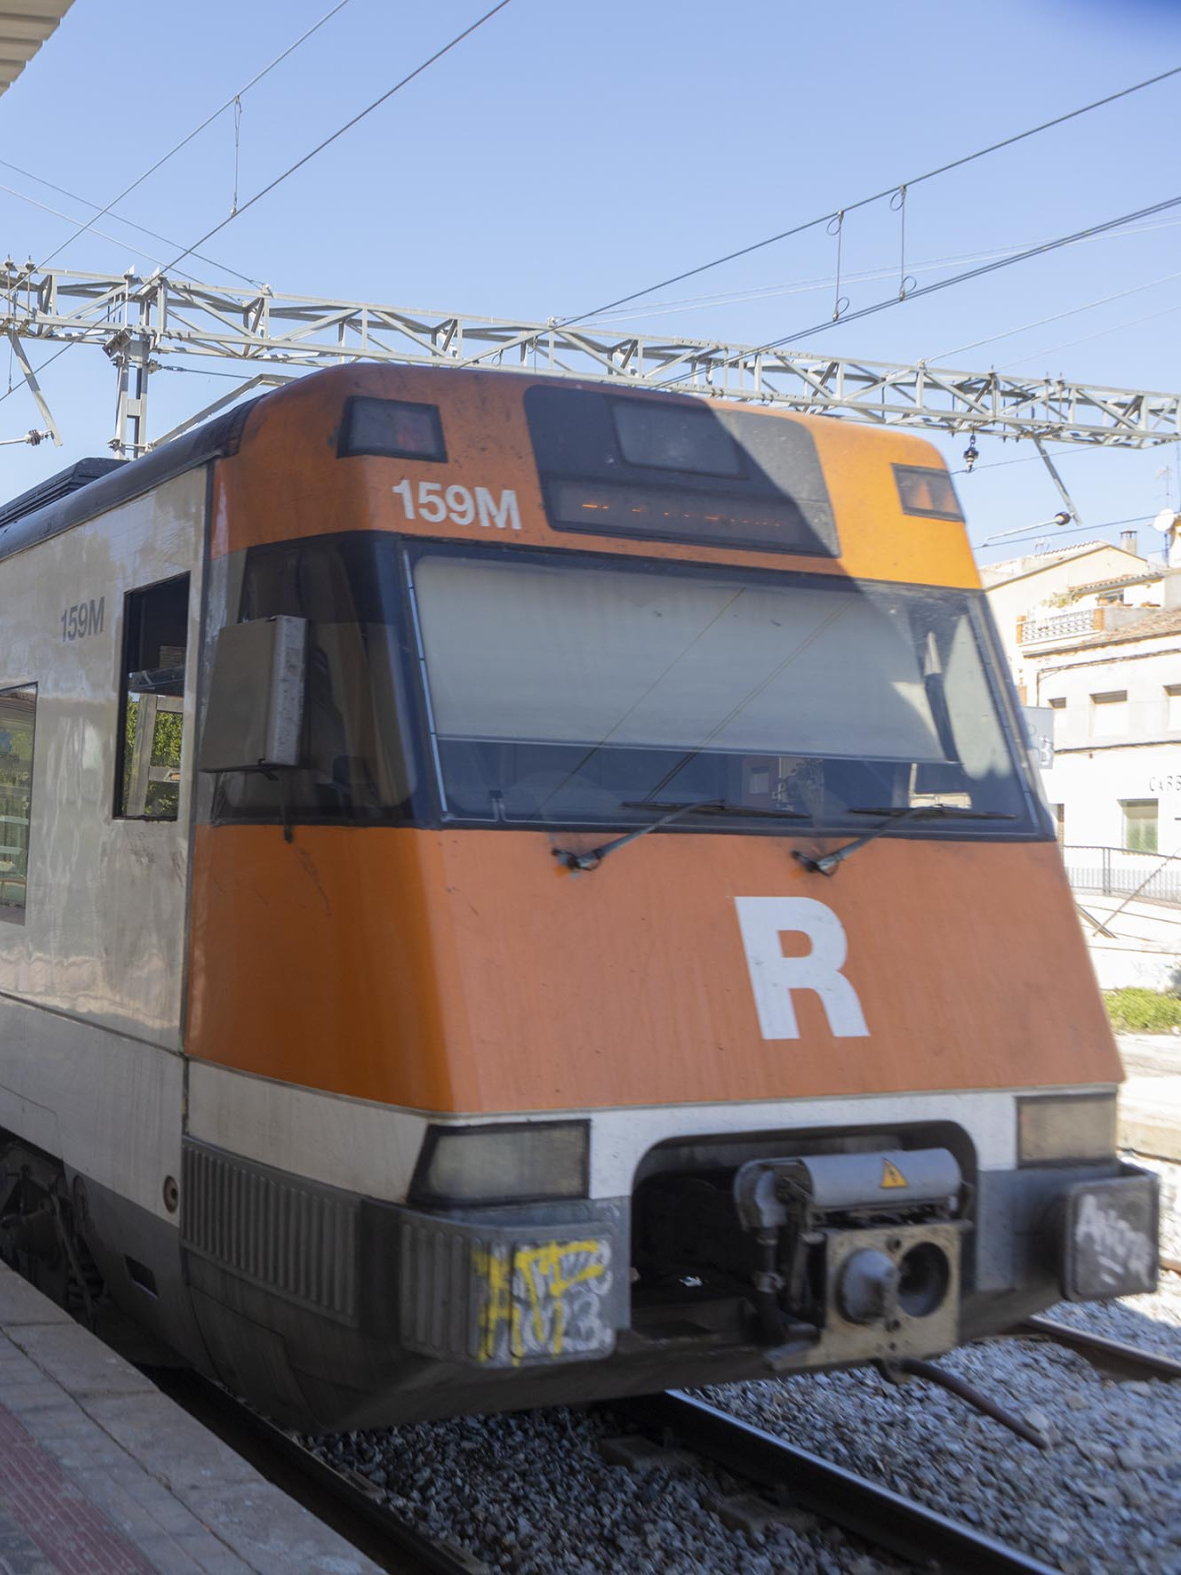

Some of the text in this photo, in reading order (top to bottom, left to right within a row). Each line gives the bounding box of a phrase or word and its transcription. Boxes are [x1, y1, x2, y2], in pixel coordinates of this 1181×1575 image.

[392, 479, 522, 530] 159M
[60, 596, 105, 643] 159M
[734, 896, 870, 1039] R
